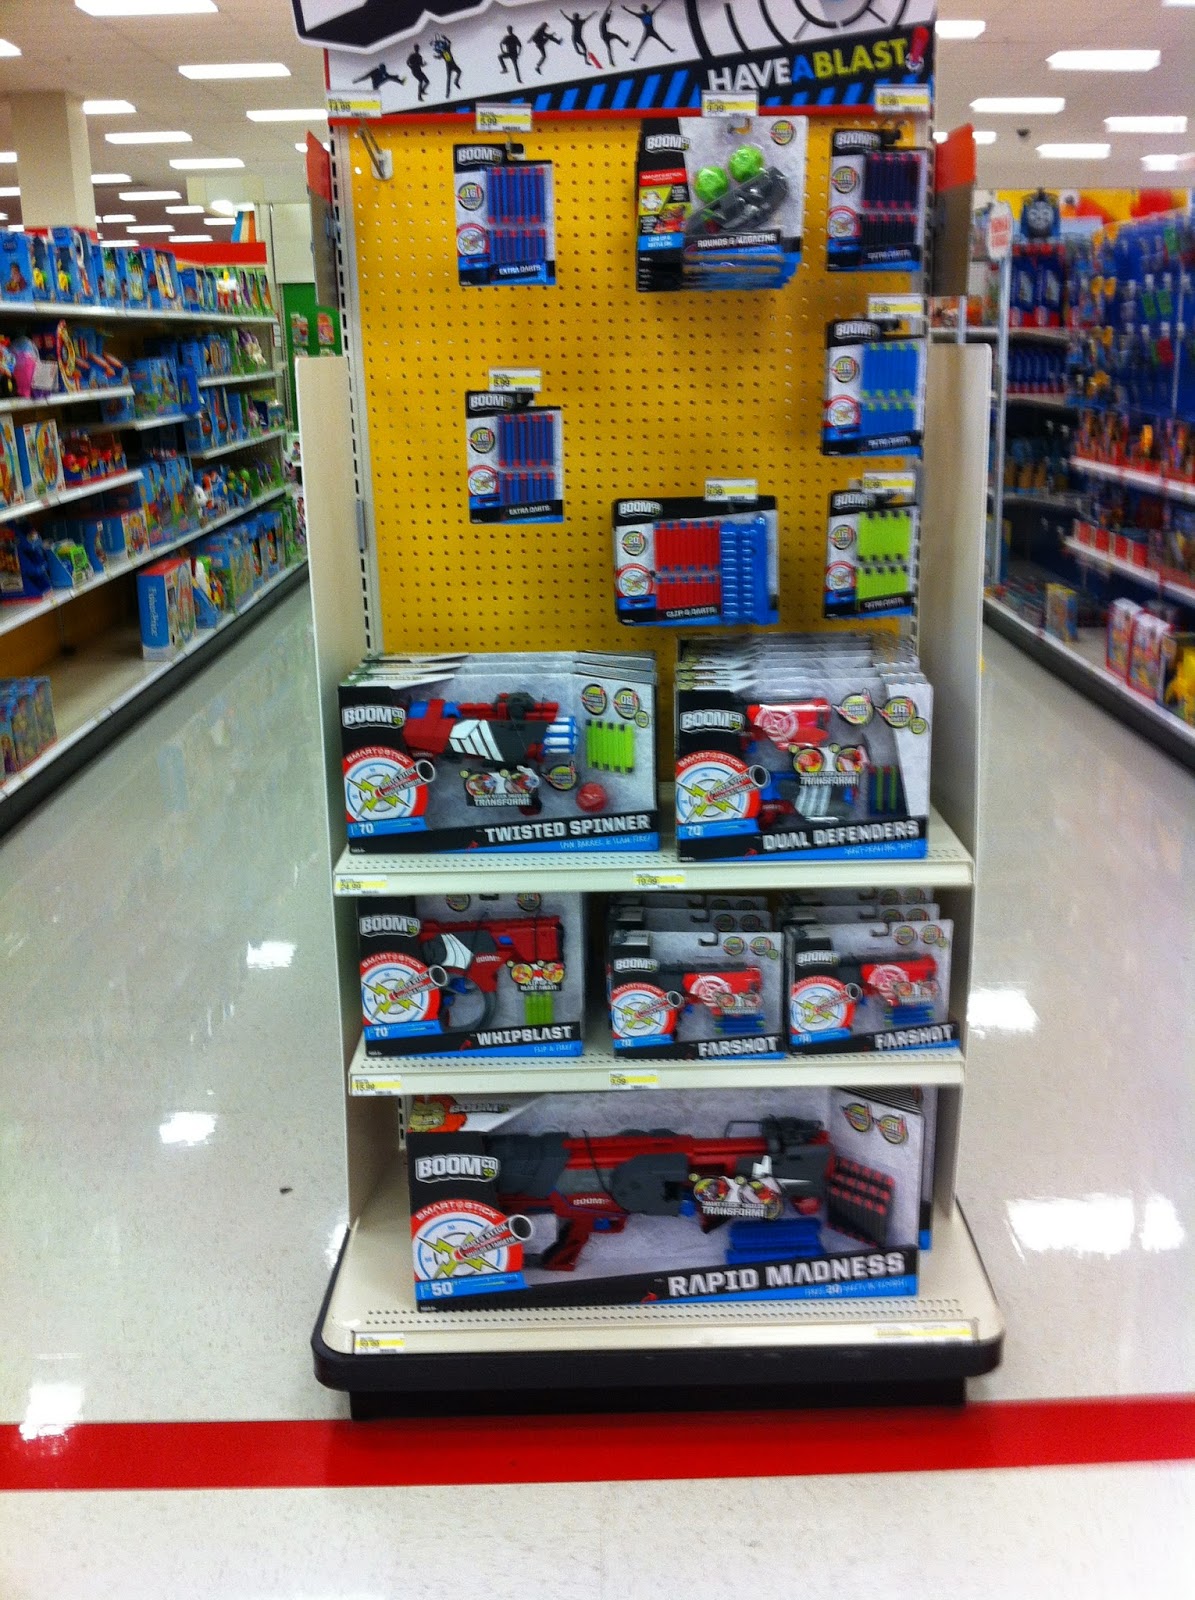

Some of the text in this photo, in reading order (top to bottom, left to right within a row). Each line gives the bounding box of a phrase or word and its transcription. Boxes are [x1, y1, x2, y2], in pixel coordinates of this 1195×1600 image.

[706, 56, 793, 91] HAVE
[791, 54, 816, 83] A
[359, 822, 375, 835] 70
[484, 813, 651, 844] TWISTED SPINNER
[762, 819, 920, 850] DUAL DEFENDERS
[374, 1026, 389, 1038] 70
[475, 1025, 574, 1046] WHIPBLAST
[874, 1023, 954, 1050] FARSHOT
[698, 1036, 778, 1057] FARSHOT
[415, 1201, 500, 1220] SMART STICK
[667, 1251, 906, 1297] RAPID MADNESS
[431, 1281, 454, 1297] 50
